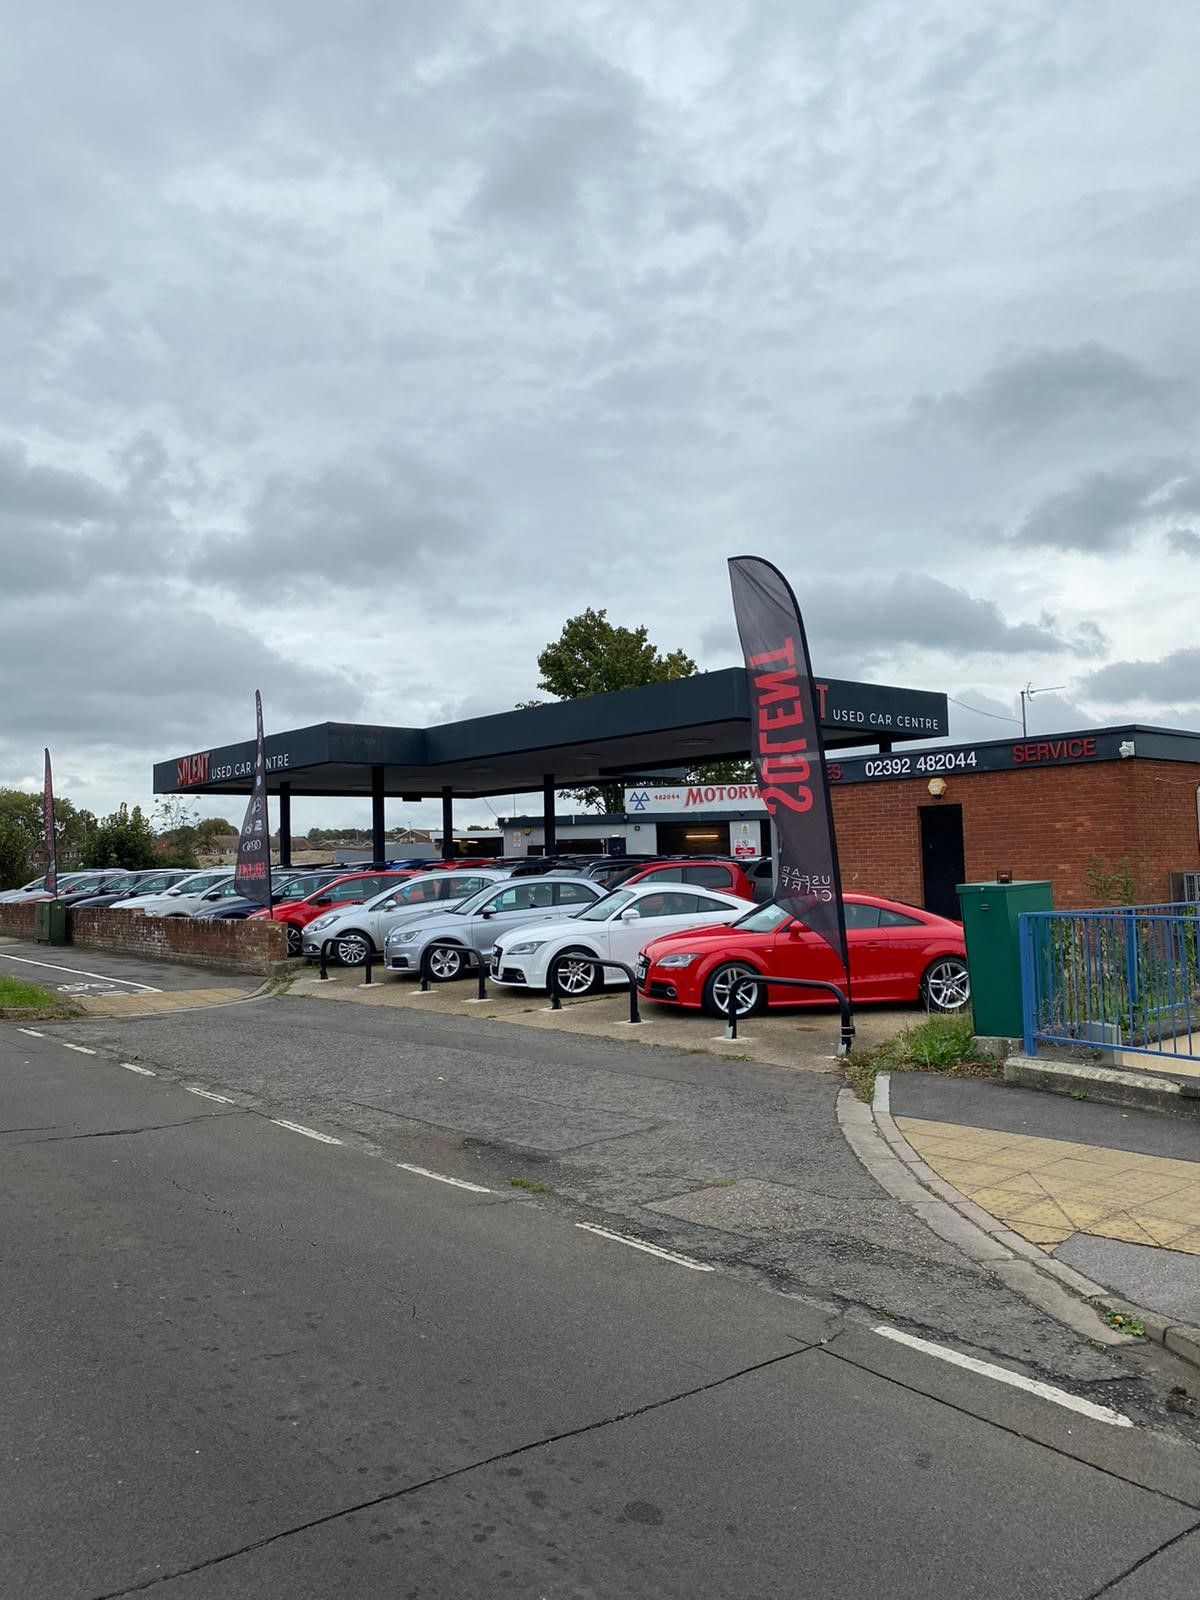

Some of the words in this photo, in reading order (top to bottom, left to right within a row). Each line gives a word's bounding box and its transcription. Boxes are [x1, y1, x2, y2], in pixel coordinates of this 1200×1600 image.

[833, 709, 865, 723] USED
[869, 712, 893, 726] CAR
[897, 715, 939, 730] CENTRE
[865, 758, 911, 777] 02392
[916, 751, 978, 773] 482044
[1011, 738, 1097, 764] SERVICE
[177, 753, 210, 786] SOLENT
[211, 765, 232, 780] USED
[234, 761, 252, 775] CAR
